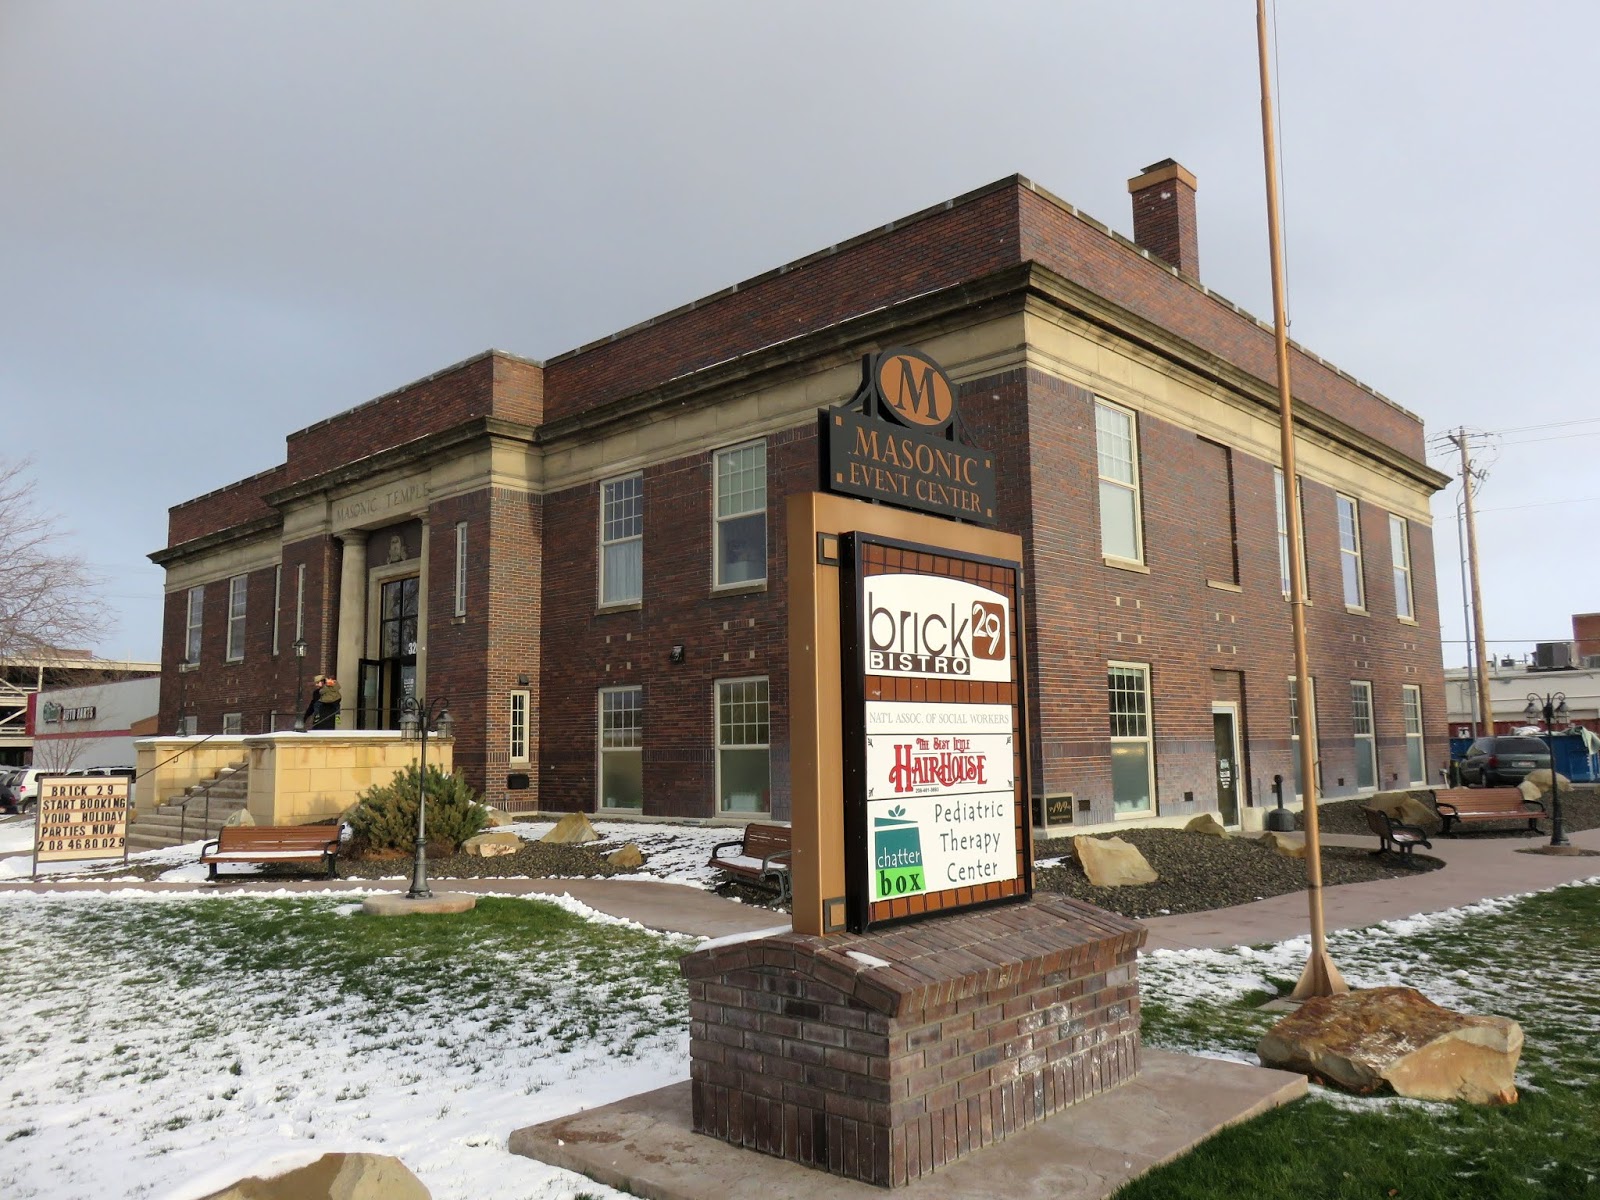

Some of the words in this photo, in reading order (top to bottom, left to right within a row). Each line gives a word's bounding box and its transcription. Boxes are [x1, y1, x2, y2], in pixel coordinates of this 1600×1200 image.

[893, 356, 942, 422] M
[853, 426, 978, 486] MASONIC
[386, 481, 430, 508] TEMPLE
[850, 463, 911, 497] EVENT
[915, 479, 982, 513] CENTER
[869, 591, 970, 658] brick
[972, 603, 1001, 656] 29
[870, 651, 968, 674] BISTRO
[869, 712, 894, 724] NAT'L
[896, 712, 924, 724] ASSOC.
[925, 713, 937, 724] OF
[939, 713, 968, 724] SOCIAL
[969, 713, 1010, 724] WORKERS
[933, 737, 950, 750] BEST
[52, 785, 88, 797] BRICK
[43, 799, 76, 811] START
[80, 797, 126, 809] BOOKING
[935, 800, 1004, 823] Pediatric
[43, 813, 71, 824] YOUR
[82, 811, 124, 823] HOLIDAY
[41, 826, 86, 838] PARTIES
[92, 824, 116, 835] NOW
[940, 828, 1001, 853] Therapy
[877, 847, 921, 868] chatter
[947, 859, 998, 882] Center
[880, 869, 922, 896] box
